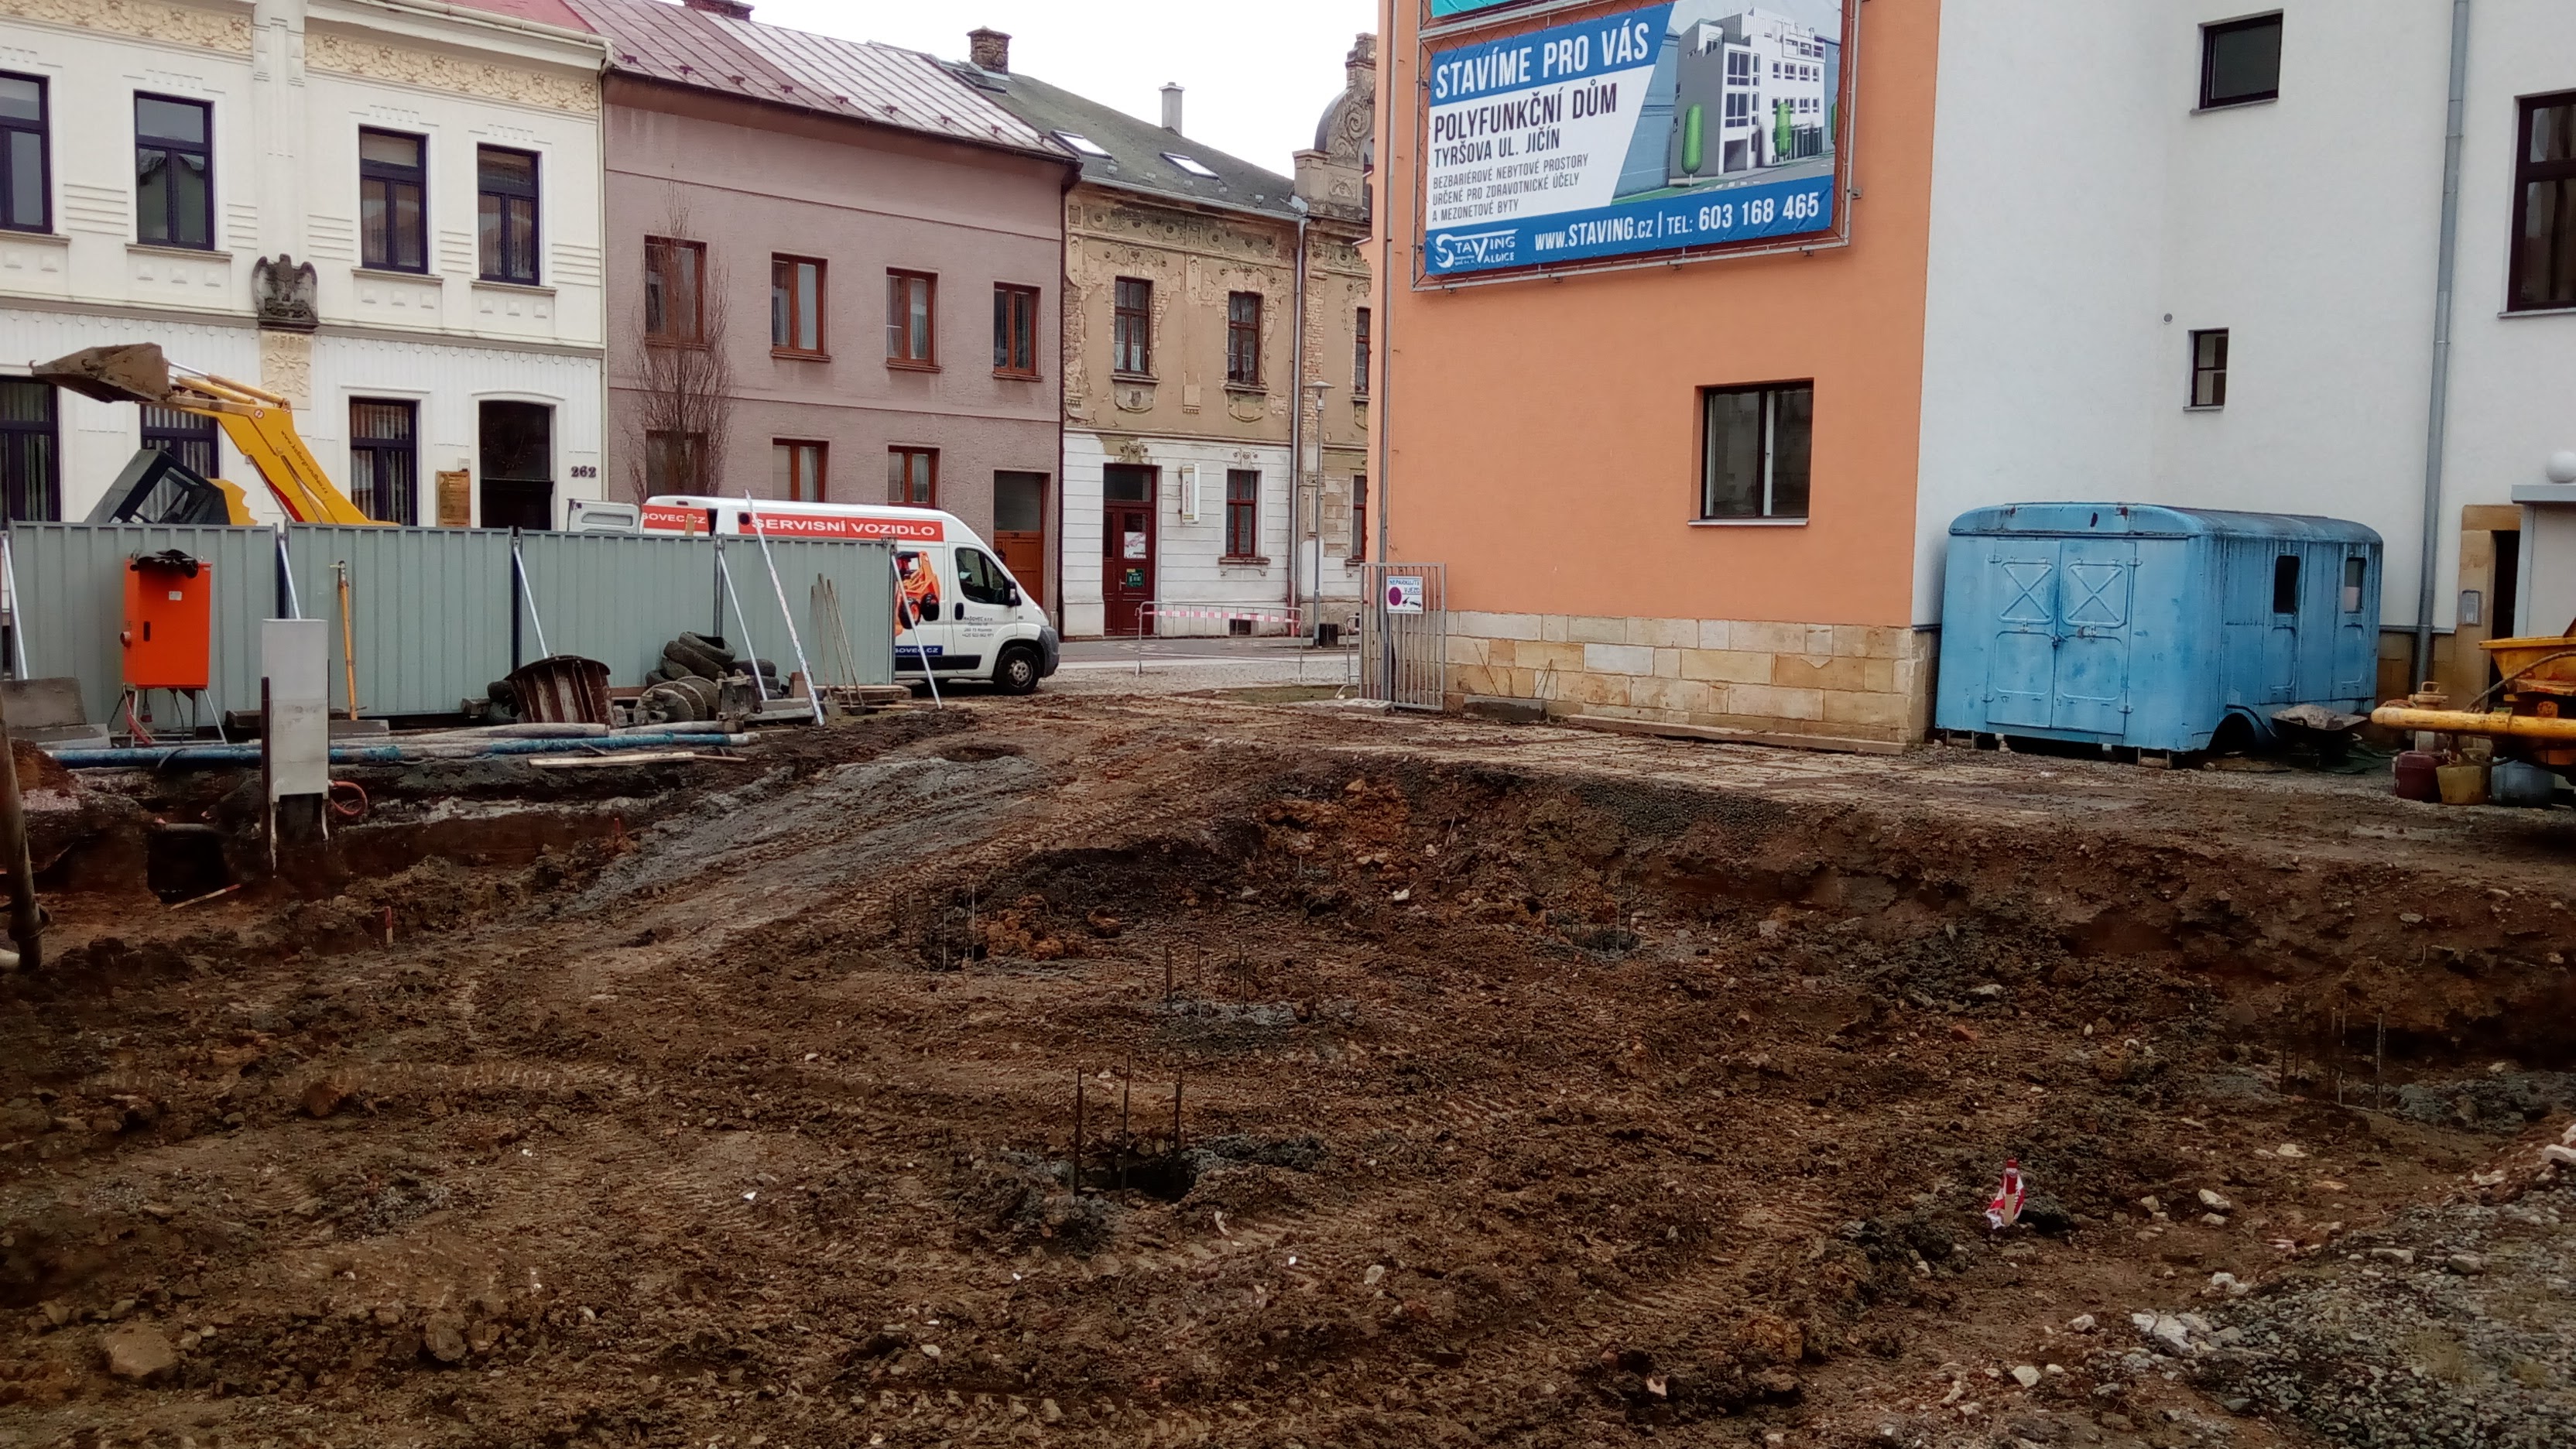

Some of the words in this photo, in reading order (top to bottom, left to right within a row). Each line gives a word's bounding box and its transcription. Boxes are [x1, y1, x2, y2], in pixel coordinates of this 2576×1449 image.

[1436, 46, 1532, 99] STAVÍME
[1543, 36, 1589, 78] PRO
[1601, 19, 1649, 67] VÁS
[1434, 87, 1564, 143] POLYFUNKČNÍ
[1573, 79, 1617, 119] DŮM
[1434, 140, 1492, 168] TYRŠOVA
[1499, 137, 1519, 158] UL.
[1526, 125, 1560, 153] JIČÍN
[1433, 166, 1493, 190] BEZBARIÉROVÉ
[1496, 158, 1540, 180] NEBYTOVÉ
[1543, 153, 1588, 173] PROSTORY
[1433, 189, 1464, 206] URČENÉ
[1467, 187, 1482, 200] PRO
[1486, 175, 1549, 199] ZDRAVOTNICKÉ
[1553, 171, 1580, 189] ÚČELY
[1432, 210, 1437, 222] A
[1441, 200, 1494, 221] MEZONETOVÉ
[1498, 199, 1519, 214] BYTY
[1667, 215, 1693, 235] TEL:
[1698, 204, 1733, 231] 603
[1742, 198, 1774, 225] 168
[1783, 192, 1819, 221] 465
[570, 465, 597, 478] 262
[752, 518, 845, 532] SERVISNÍ
[851, 522, 934, 536] VOZIDLO
